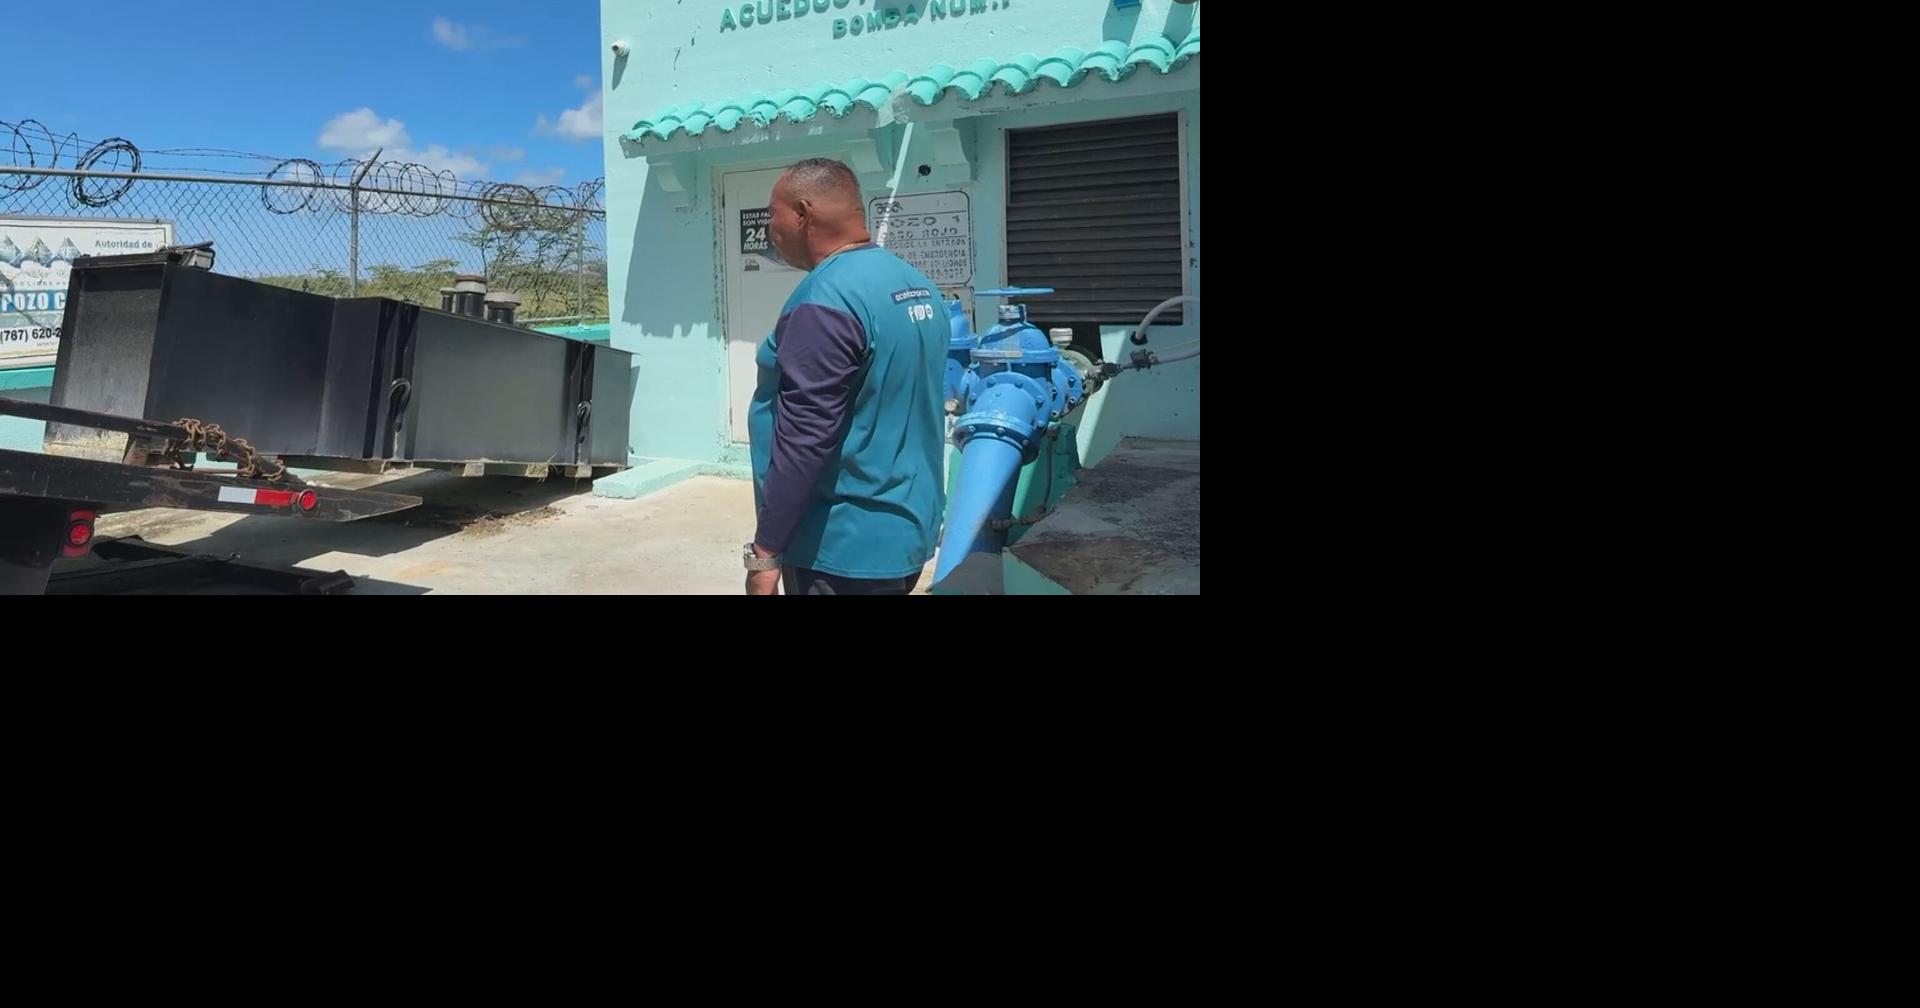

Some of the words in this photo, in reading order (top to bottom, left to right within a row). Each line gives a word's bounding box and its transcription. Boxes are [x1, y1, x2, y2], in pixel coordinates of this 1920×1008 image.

[833, 4, 919, 40] BOMBA
[745, 227, 766, 242] 24
[95, 239, 141, 249] Autoridad
[141, 240, 153, 249] de
[743, 241, 768, 250] HORAS
[1, 292, 50, 312] POZO
[0, 330, 29, 345] (787)
